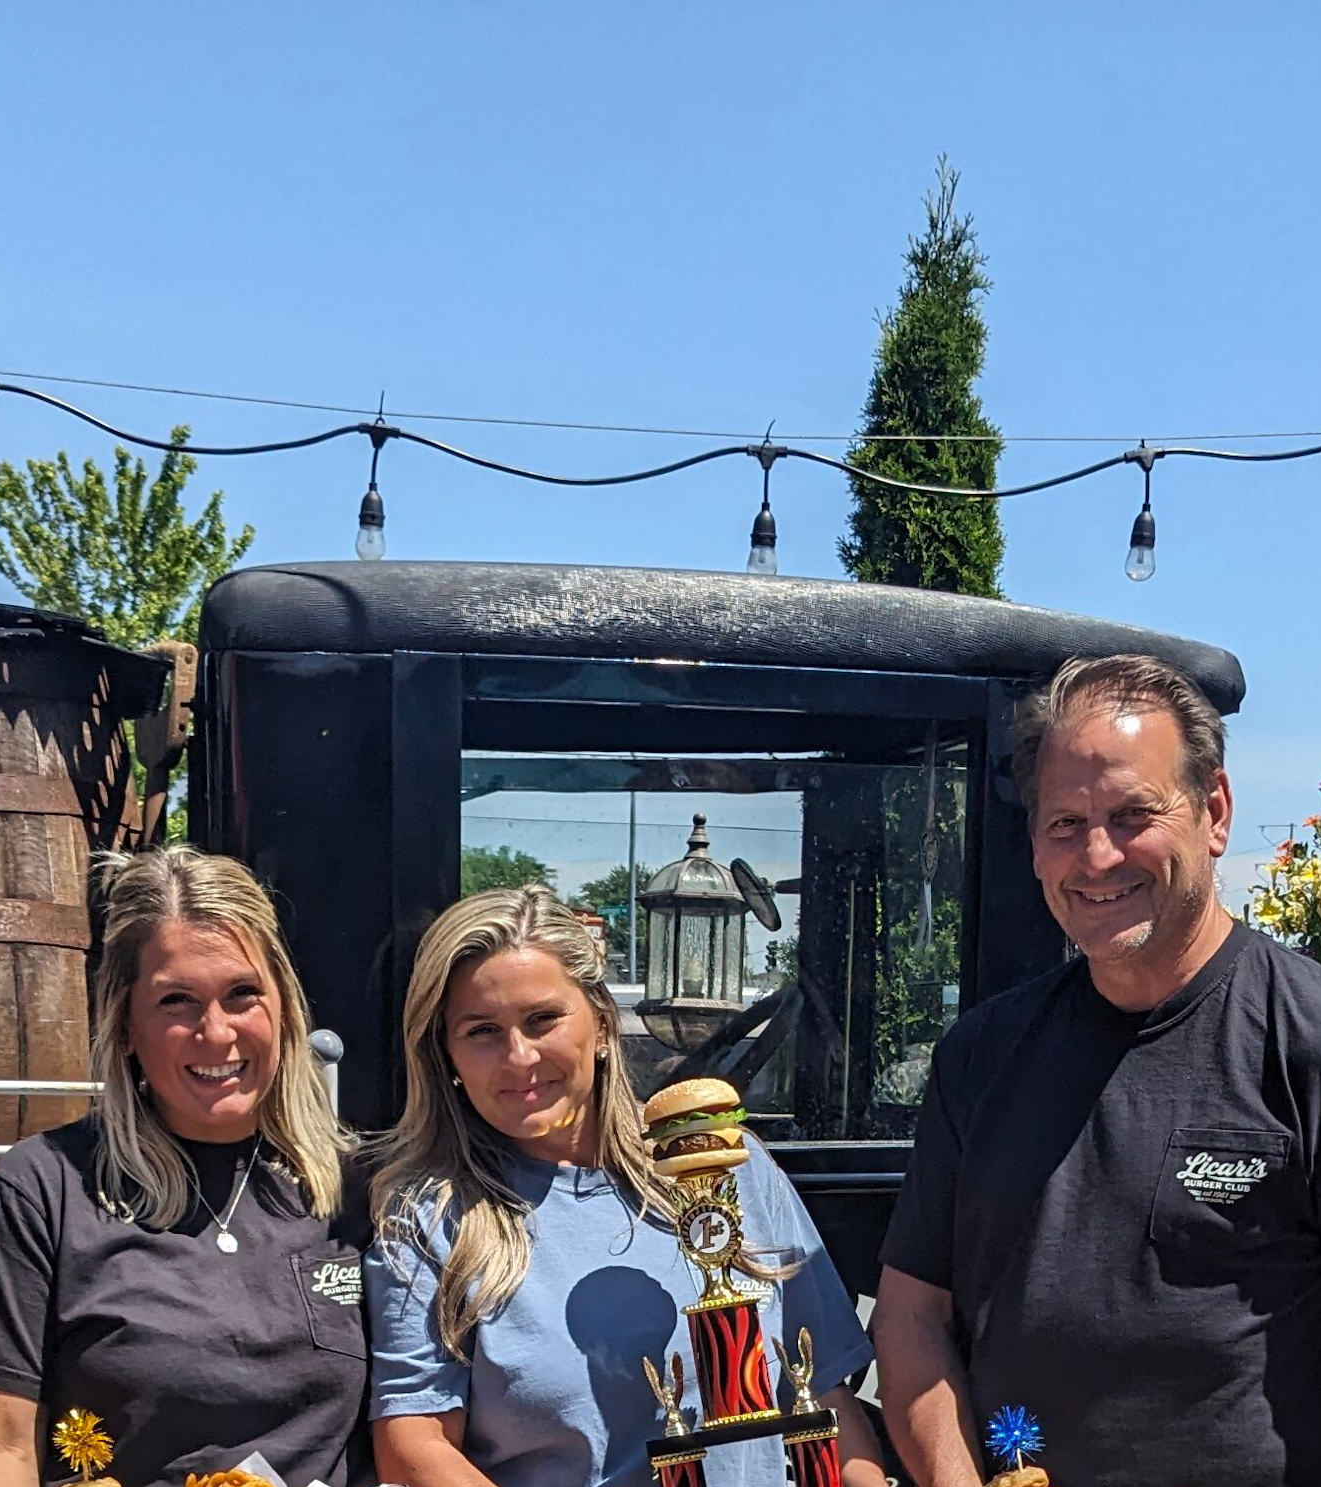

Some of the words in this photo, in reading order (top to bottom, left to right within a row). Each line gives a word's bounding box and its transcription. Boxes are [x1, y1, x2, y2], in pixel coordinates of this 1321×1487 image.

[1176, 1152, 1268, 1180] Licari's
[1184, 1179, 1222, 1190] BURGER
[1225, 1182, 1251, 1193] CLUB
[311, 1263, 361, 1292] Lica
